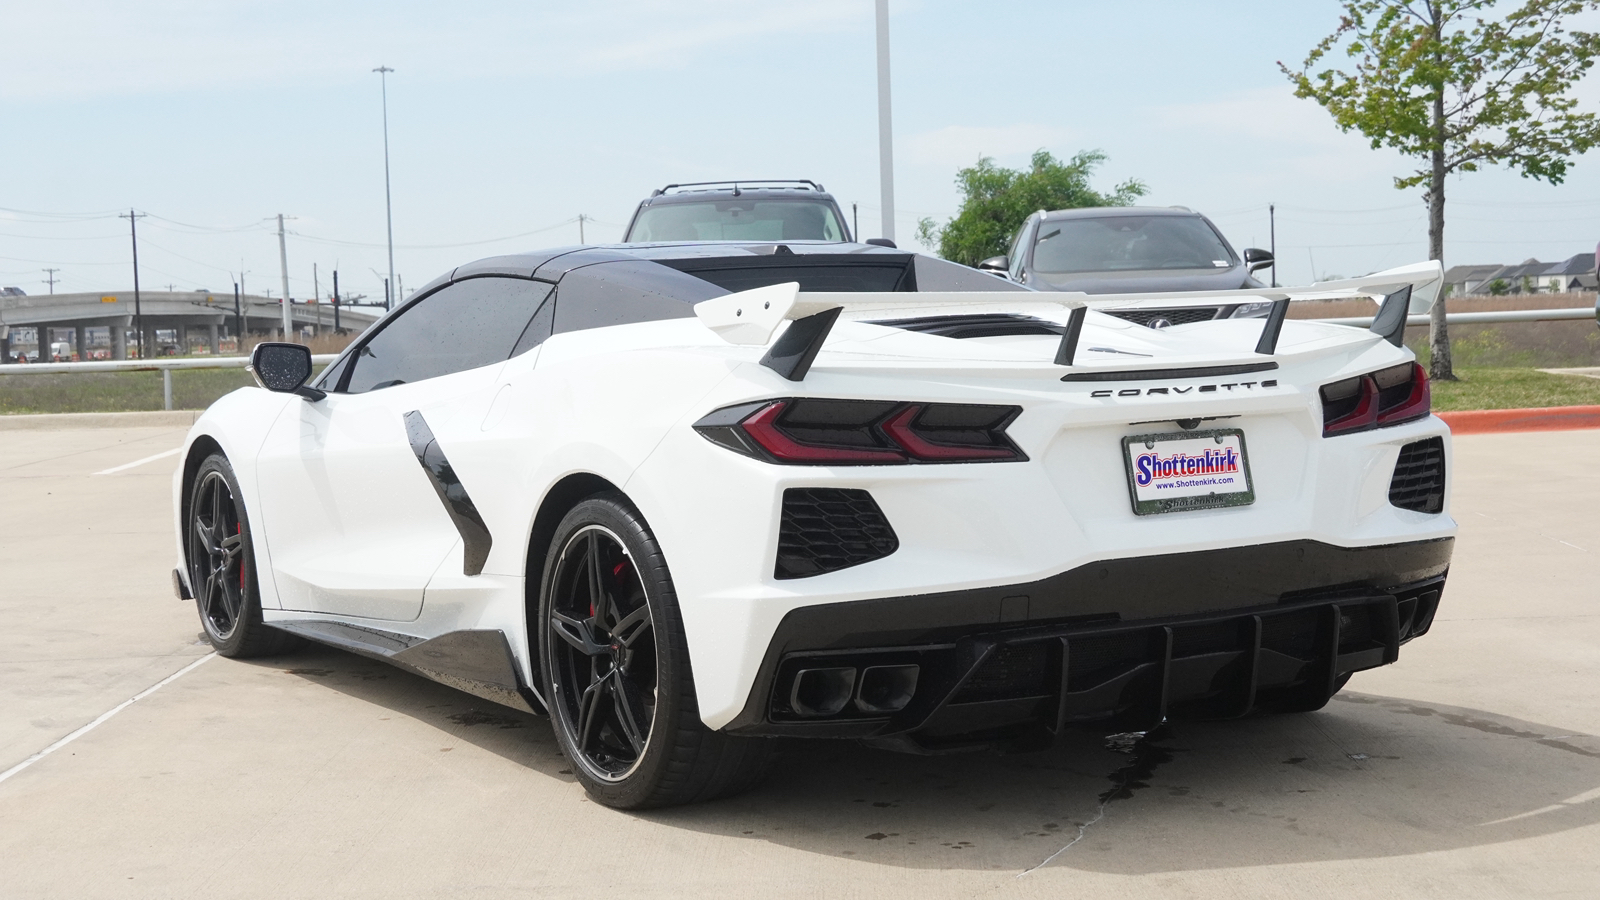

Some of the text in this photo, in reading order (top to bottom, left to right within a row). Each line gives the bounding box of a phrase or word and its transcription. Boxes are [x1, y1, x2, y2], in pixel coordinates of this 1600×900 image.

[1091, 380, 1278, 397] CORVETTE
[1137, 448, 1238, 486] Shottenkirk
[1156, 477, 1234, 489] www.Shottenkirk.com
[1164, 496, 1225, 509] Shottenkirk
